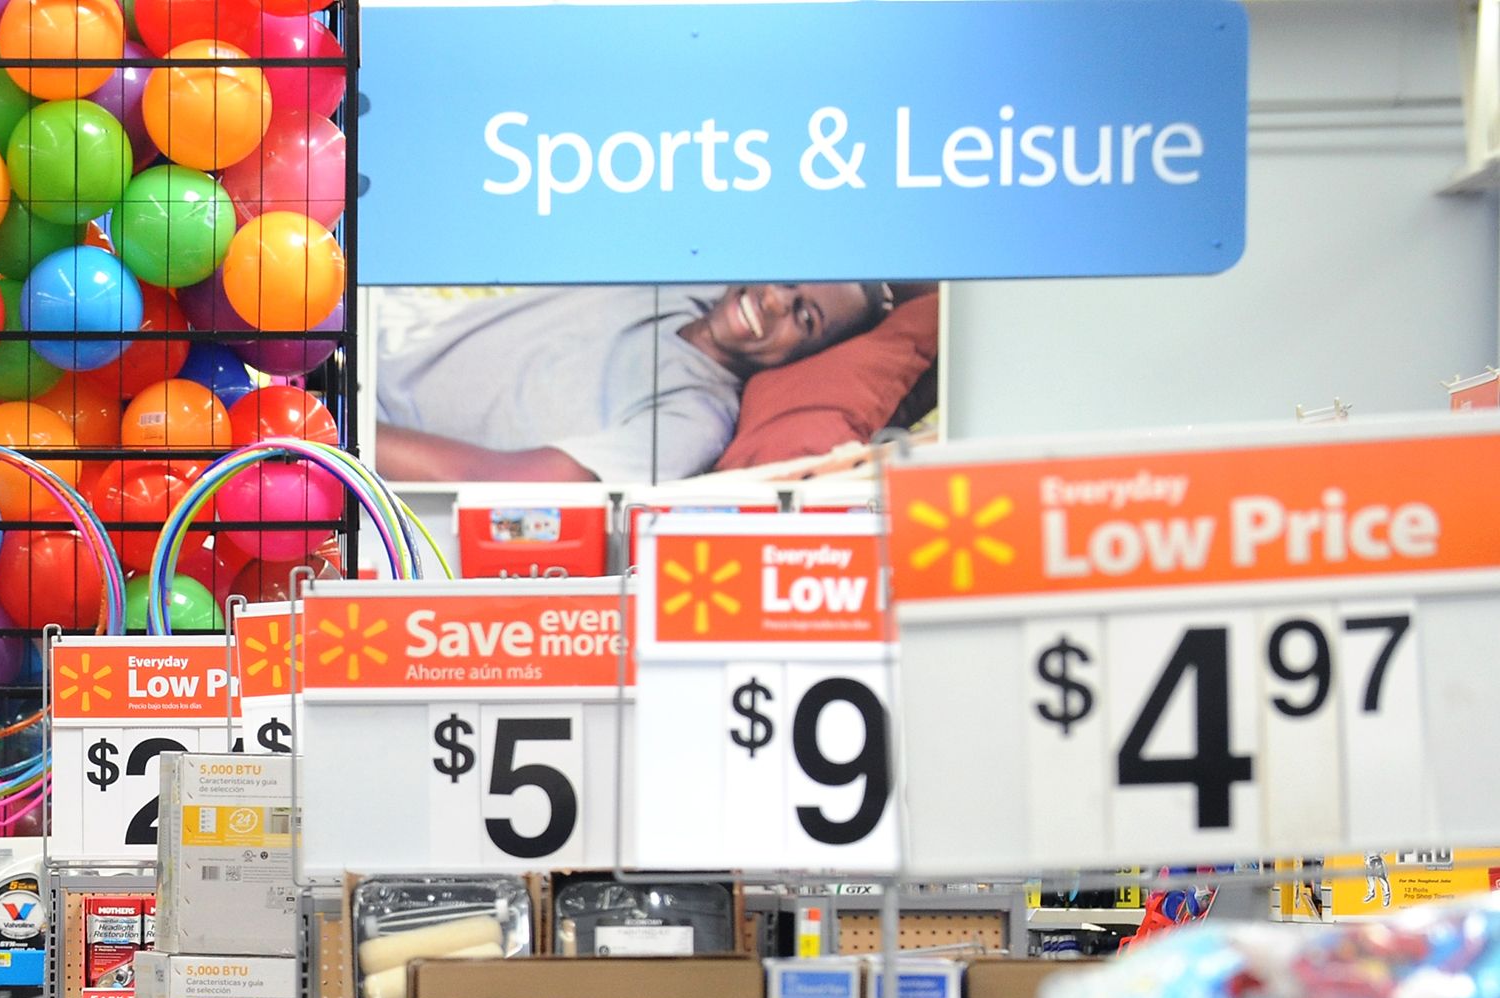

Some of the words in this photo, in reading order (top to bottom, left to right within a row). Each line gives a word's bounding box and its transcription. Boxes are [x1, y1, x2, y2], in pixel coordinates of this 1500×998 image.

[482, 111, 772, 216] Sports
[800, 106, 867, 191] &
[896, 104, 1205, 189] Leisure
[1039, 469, 1189, 508] Everyday
[1043, 508, 1216, 578] Low
[1229, 489, 1441, 567] Price
[761, 544, 852, 569] Everyday
[762, 566, 868, 612] Low
[539, 610, 620, 632] even
[405, 610, 534, 657] Save
[540, 632, 628, 657] more
[128, 656, 189, 670] Everyday
[405, 665, 465, 680] Ahorre
[469, 665, 502, 680] aún
[506, 665, 543, 680] más
[128, 669, 199, 698] Low
[128, 702, 147, 710] Precio
[147, 702, 161, 710] bajo
[161, 702, 178, 710] todos
[200, 764, 233, 776] 5,000
[236, 764, 262, 775] BTU
[199, 785, 208, 793] de
[235, 812, 252, 825] 24
[846, 885, 873, 895] GTX
[98, 906, 136, 914] MOTHERS
[186, 966, 220, 977] 5,000
[222, 966, 249, 976] BTU
[186, 986, 196, 994] de
